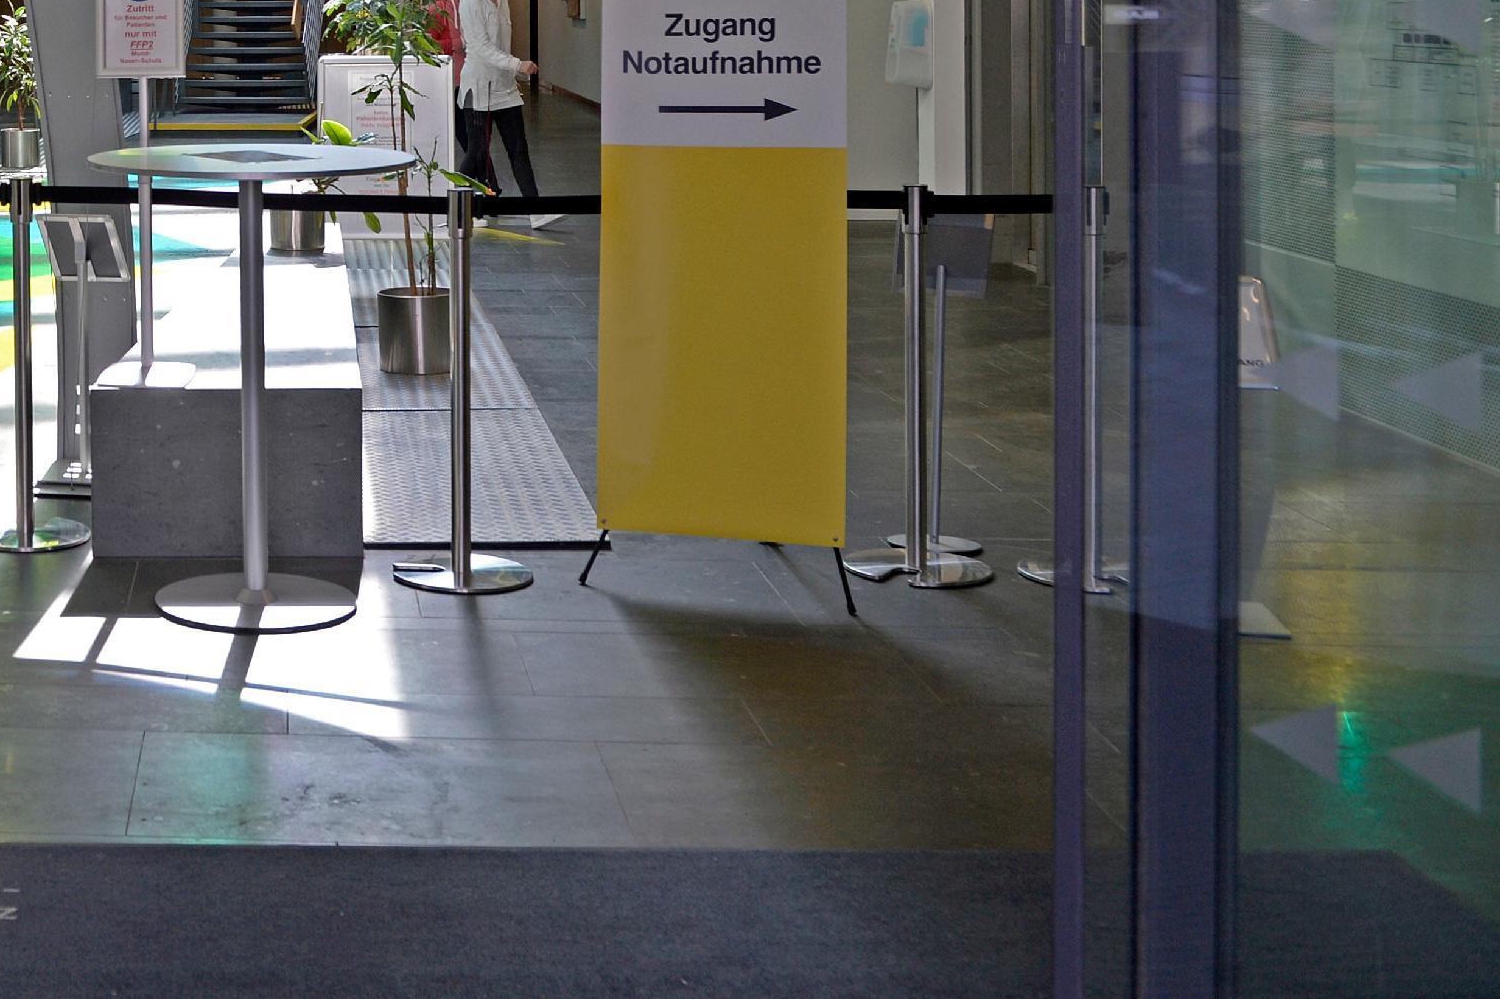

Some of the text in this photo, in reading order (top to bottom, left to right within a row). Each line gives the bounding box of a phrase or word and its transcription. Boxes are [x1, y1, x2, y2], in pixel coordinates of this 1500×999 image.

[126, 4, 155, 13] Zutritt
[664, 13, 776, 43] Zugang
[142, 30, 157, 38] mit
[130, 40, 154, 49] FFP2
[622, 50, 822, 75] Notaufnahme
